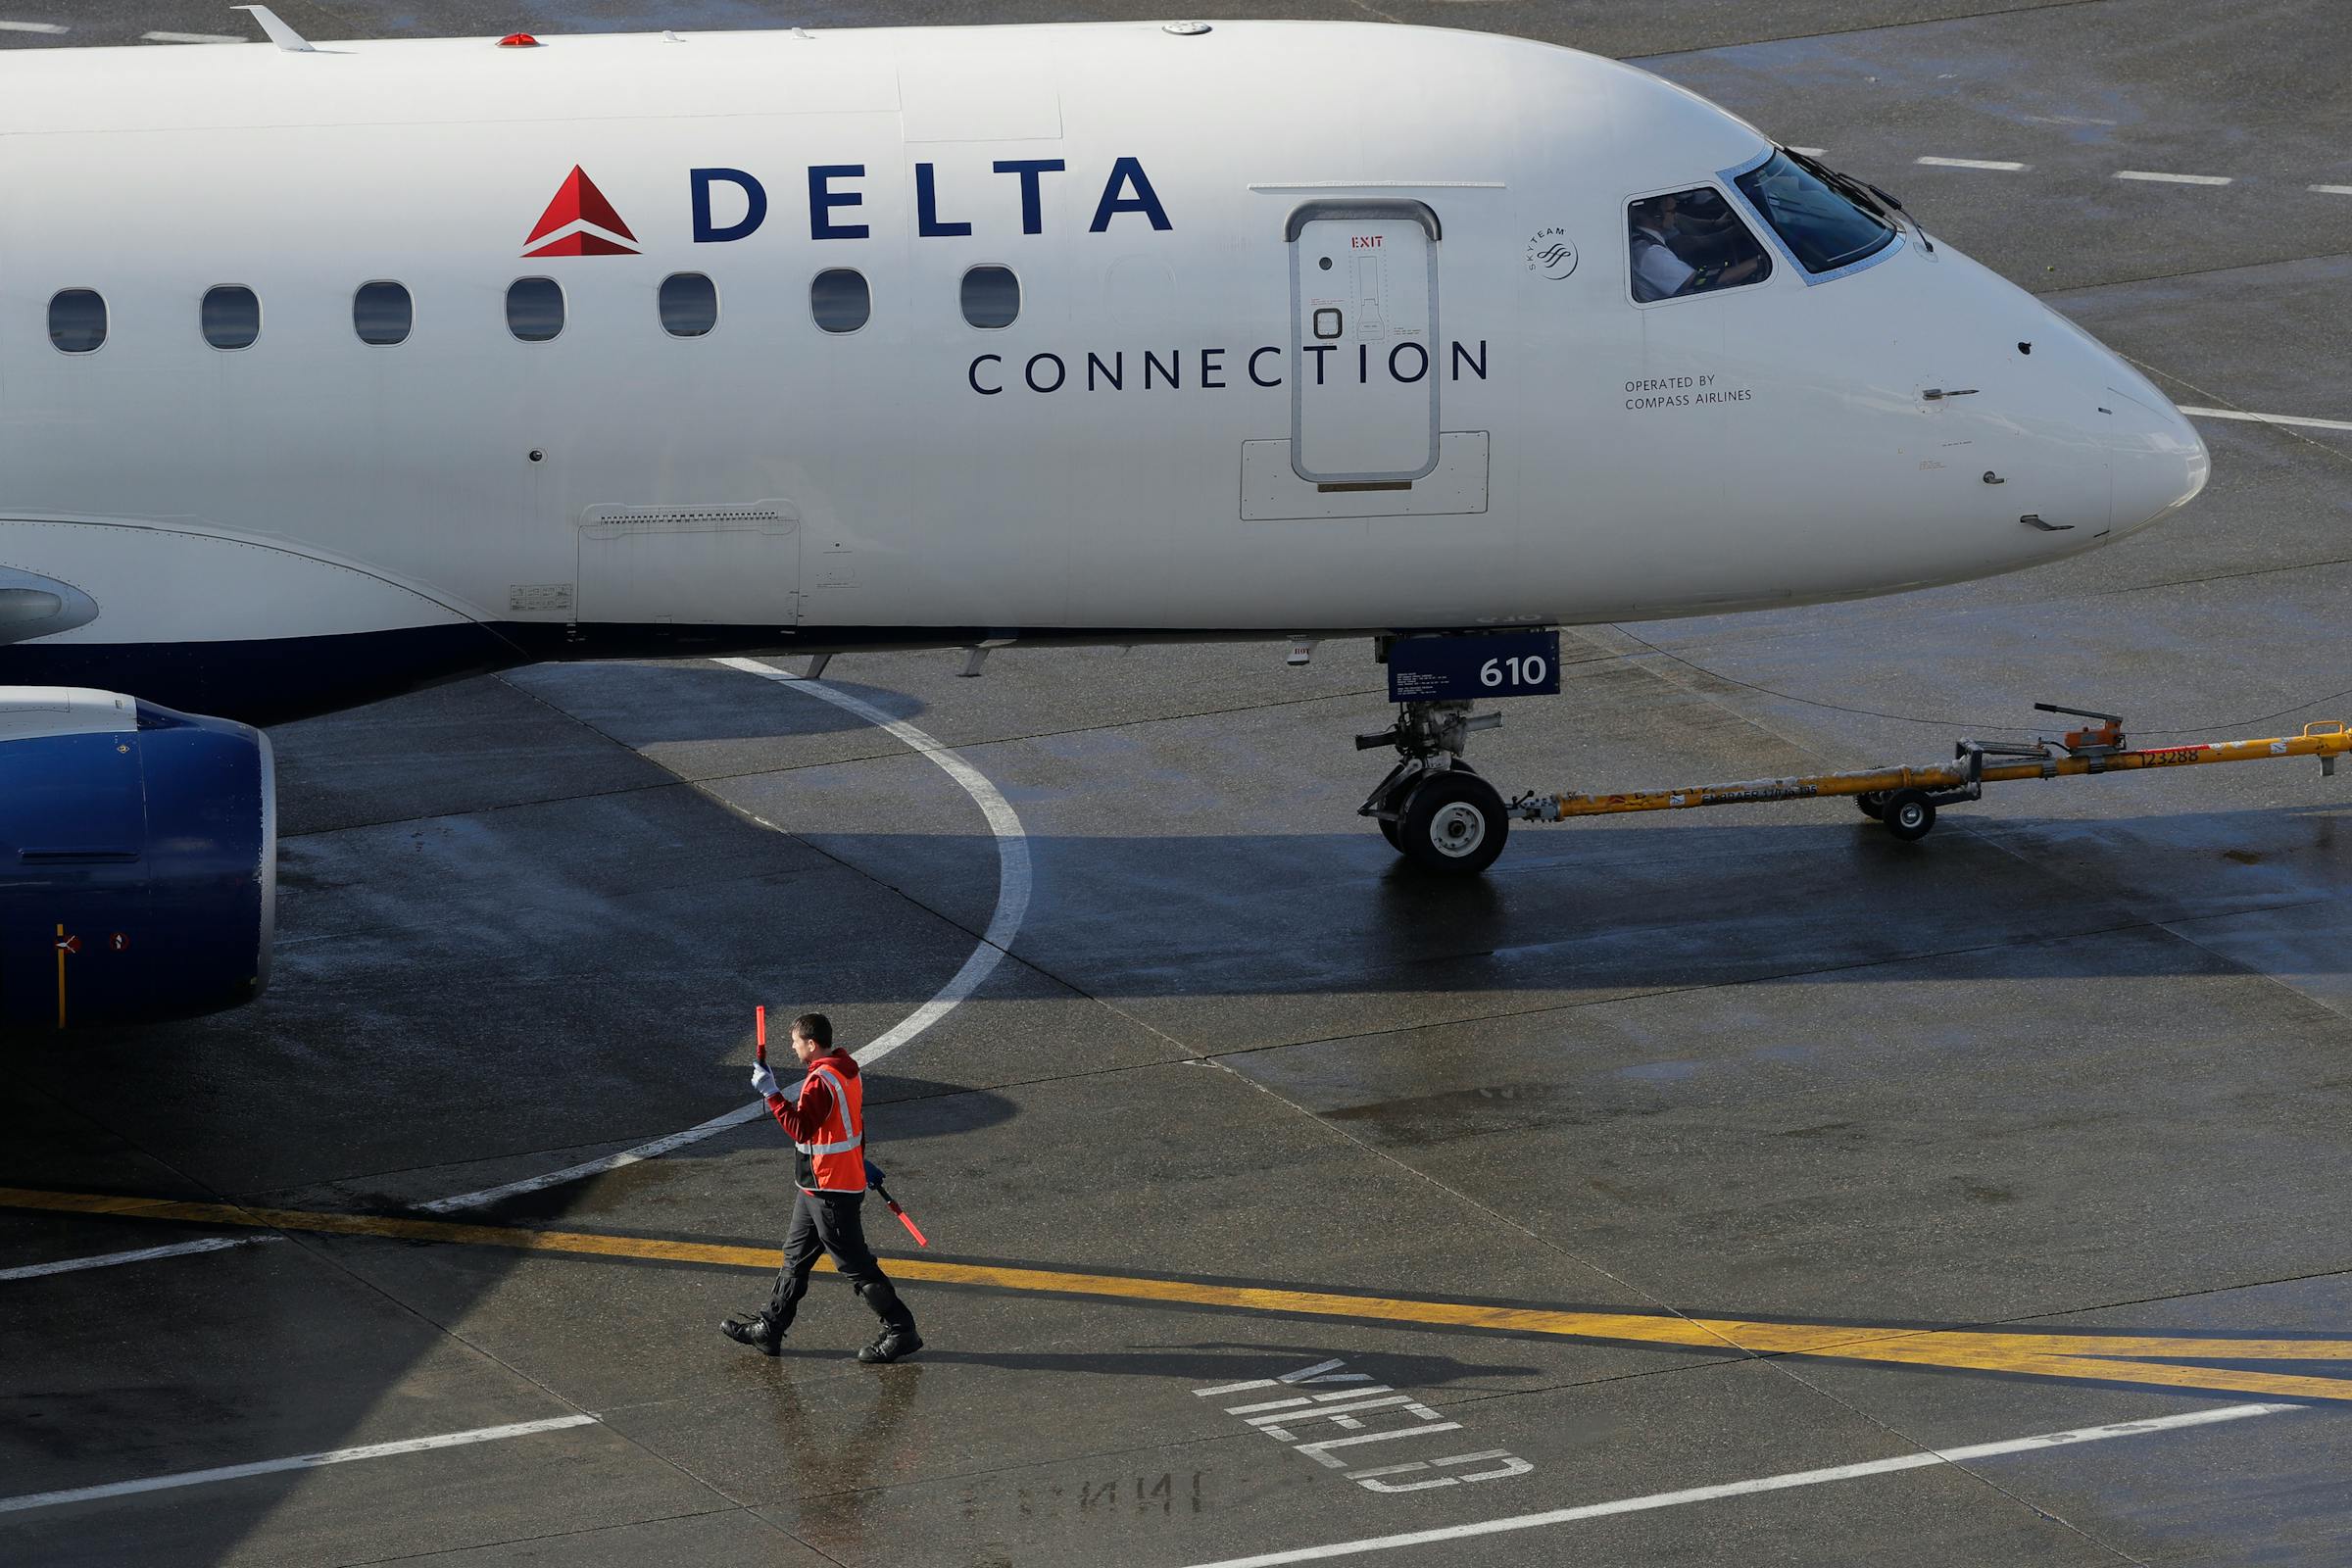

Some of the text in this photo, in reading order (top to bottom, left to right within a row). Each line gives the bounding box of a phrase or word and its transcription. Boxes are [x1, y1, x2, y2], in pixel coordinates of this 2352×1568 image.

[689, 156, 1174, 243] DELTA
[1350, 235, 1384, 248] EXIT
[1526, 226, 1565, 271] SKYTEAM
[967, 339, 1488, 395] CONNECTION
[1624, 374, 1715, 392] OPERATED BY
[1625, 389, 1752, 410] COMPASS AIRLINES
[1480, 655, 1546, 687] 610
[2138, 750, 2199, 766] 123288
[1191, 1357, 1535, 1494] YIELD
